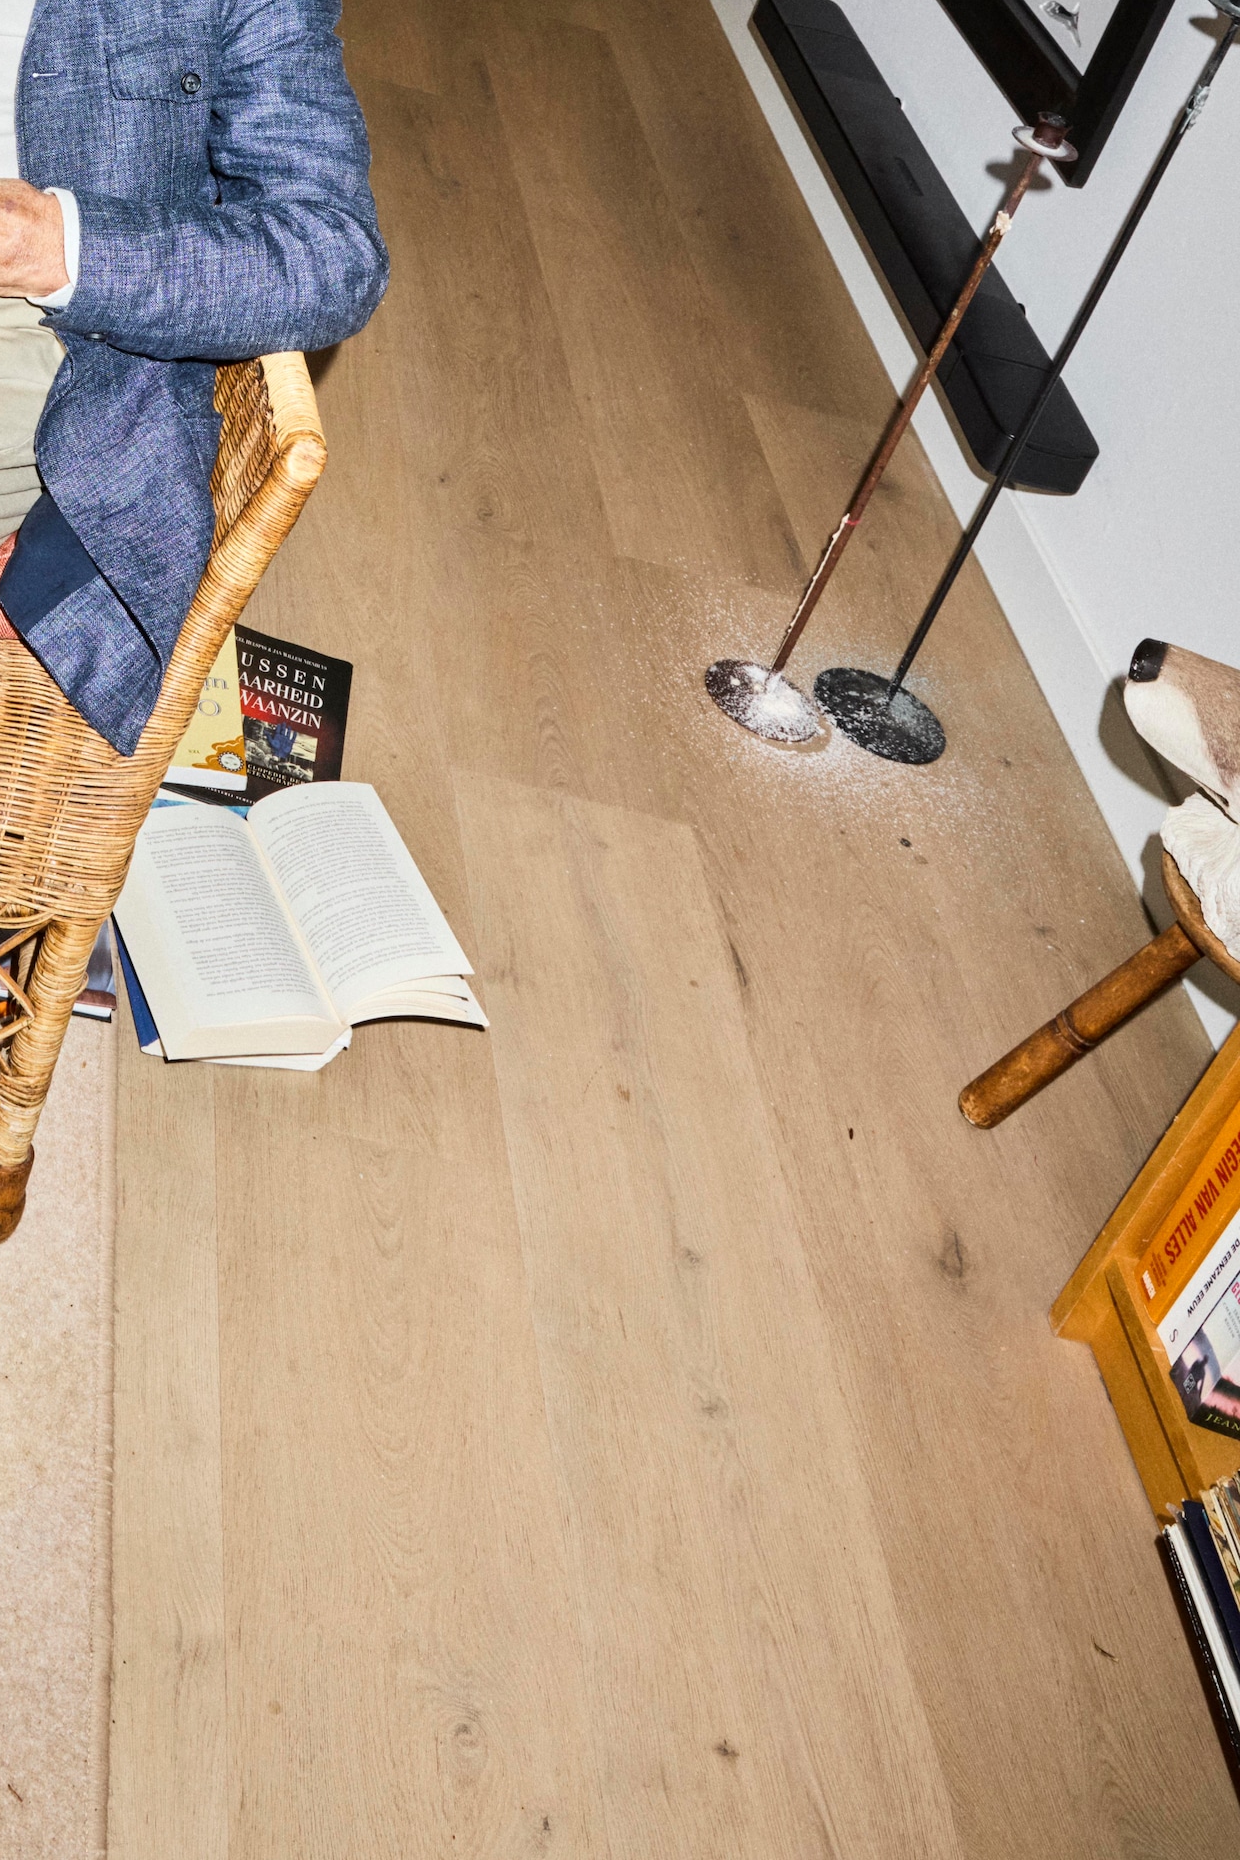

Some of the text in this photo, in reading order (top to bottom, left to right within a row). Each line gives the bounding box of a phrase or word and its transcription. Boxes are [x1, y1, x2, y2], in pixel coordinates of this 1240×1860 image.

[1194, 1178, 1220, 1218] VAN
[1164, 1206, 1198, 1266] ALLES
[1203, 1250, 1232, 1293] EENZAME
[1186, 1289, 1205, 1318] EEUW
